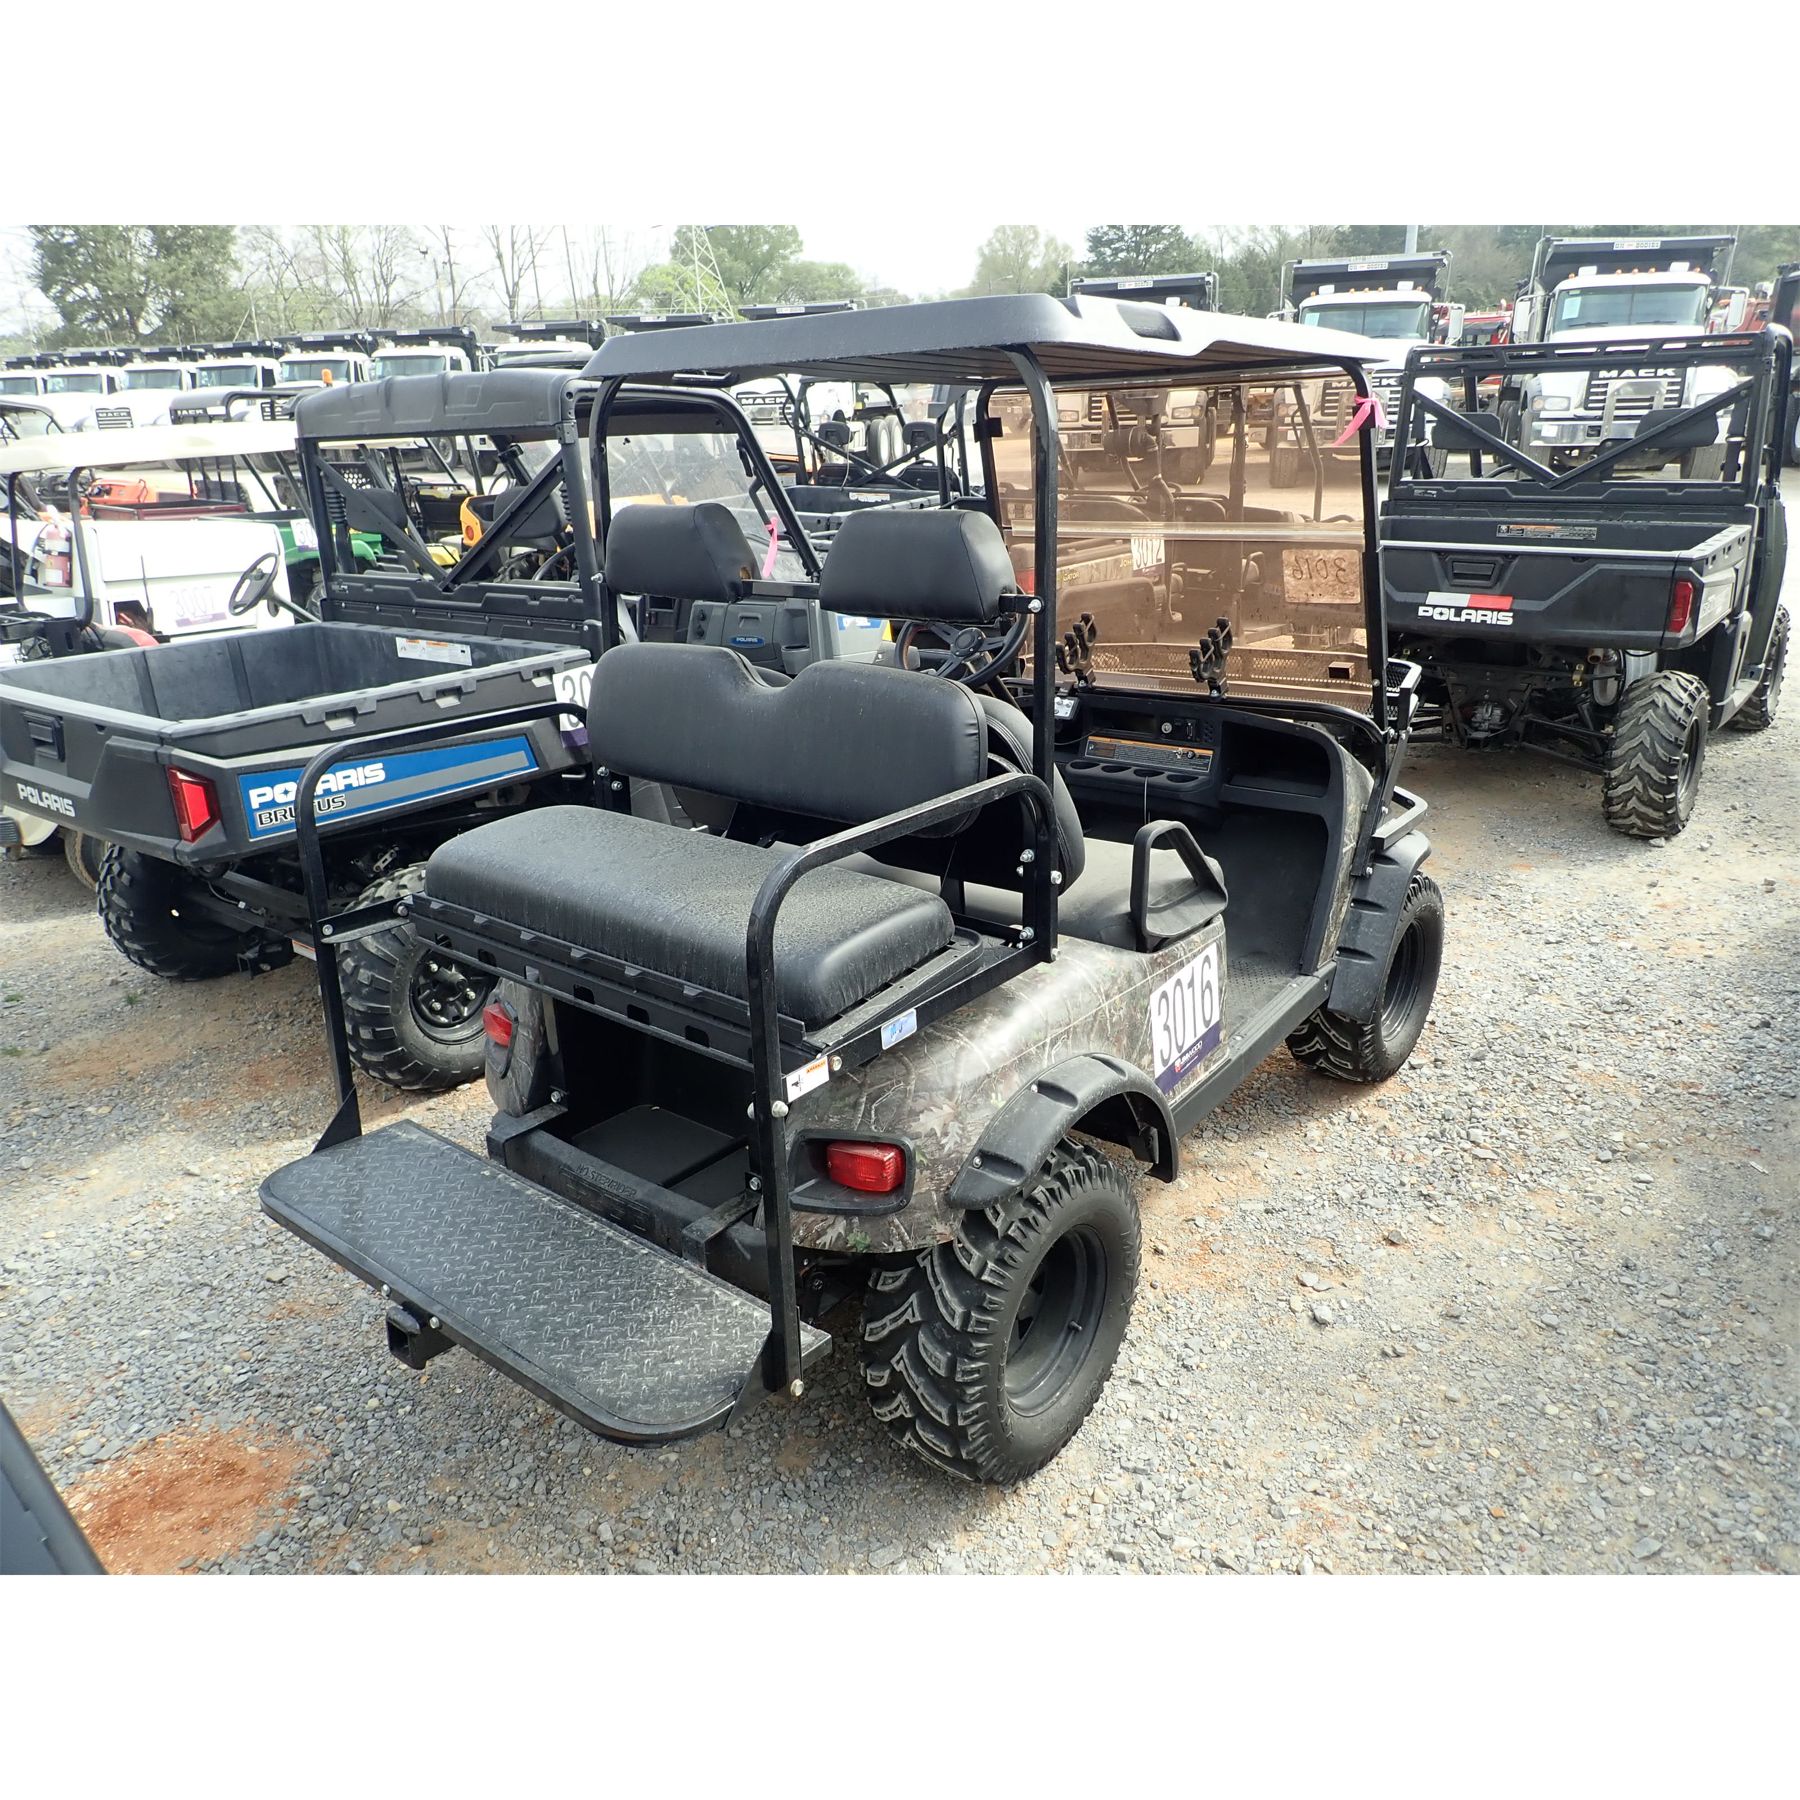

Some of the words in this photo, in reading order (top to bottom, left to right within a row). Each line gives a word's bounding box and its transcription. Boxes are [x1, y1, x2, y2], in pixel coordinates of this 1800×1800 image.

[1598, 368, 1676, 378] MACK
[1418, 606, 1514, 626] POLARIS
[16, 783, 76, 817] POLARIS
[249, 762, 386, 809] POARIS
[258, 795, 346, 827] BRUS
[1157, 954, 1214, 1068] 3016
